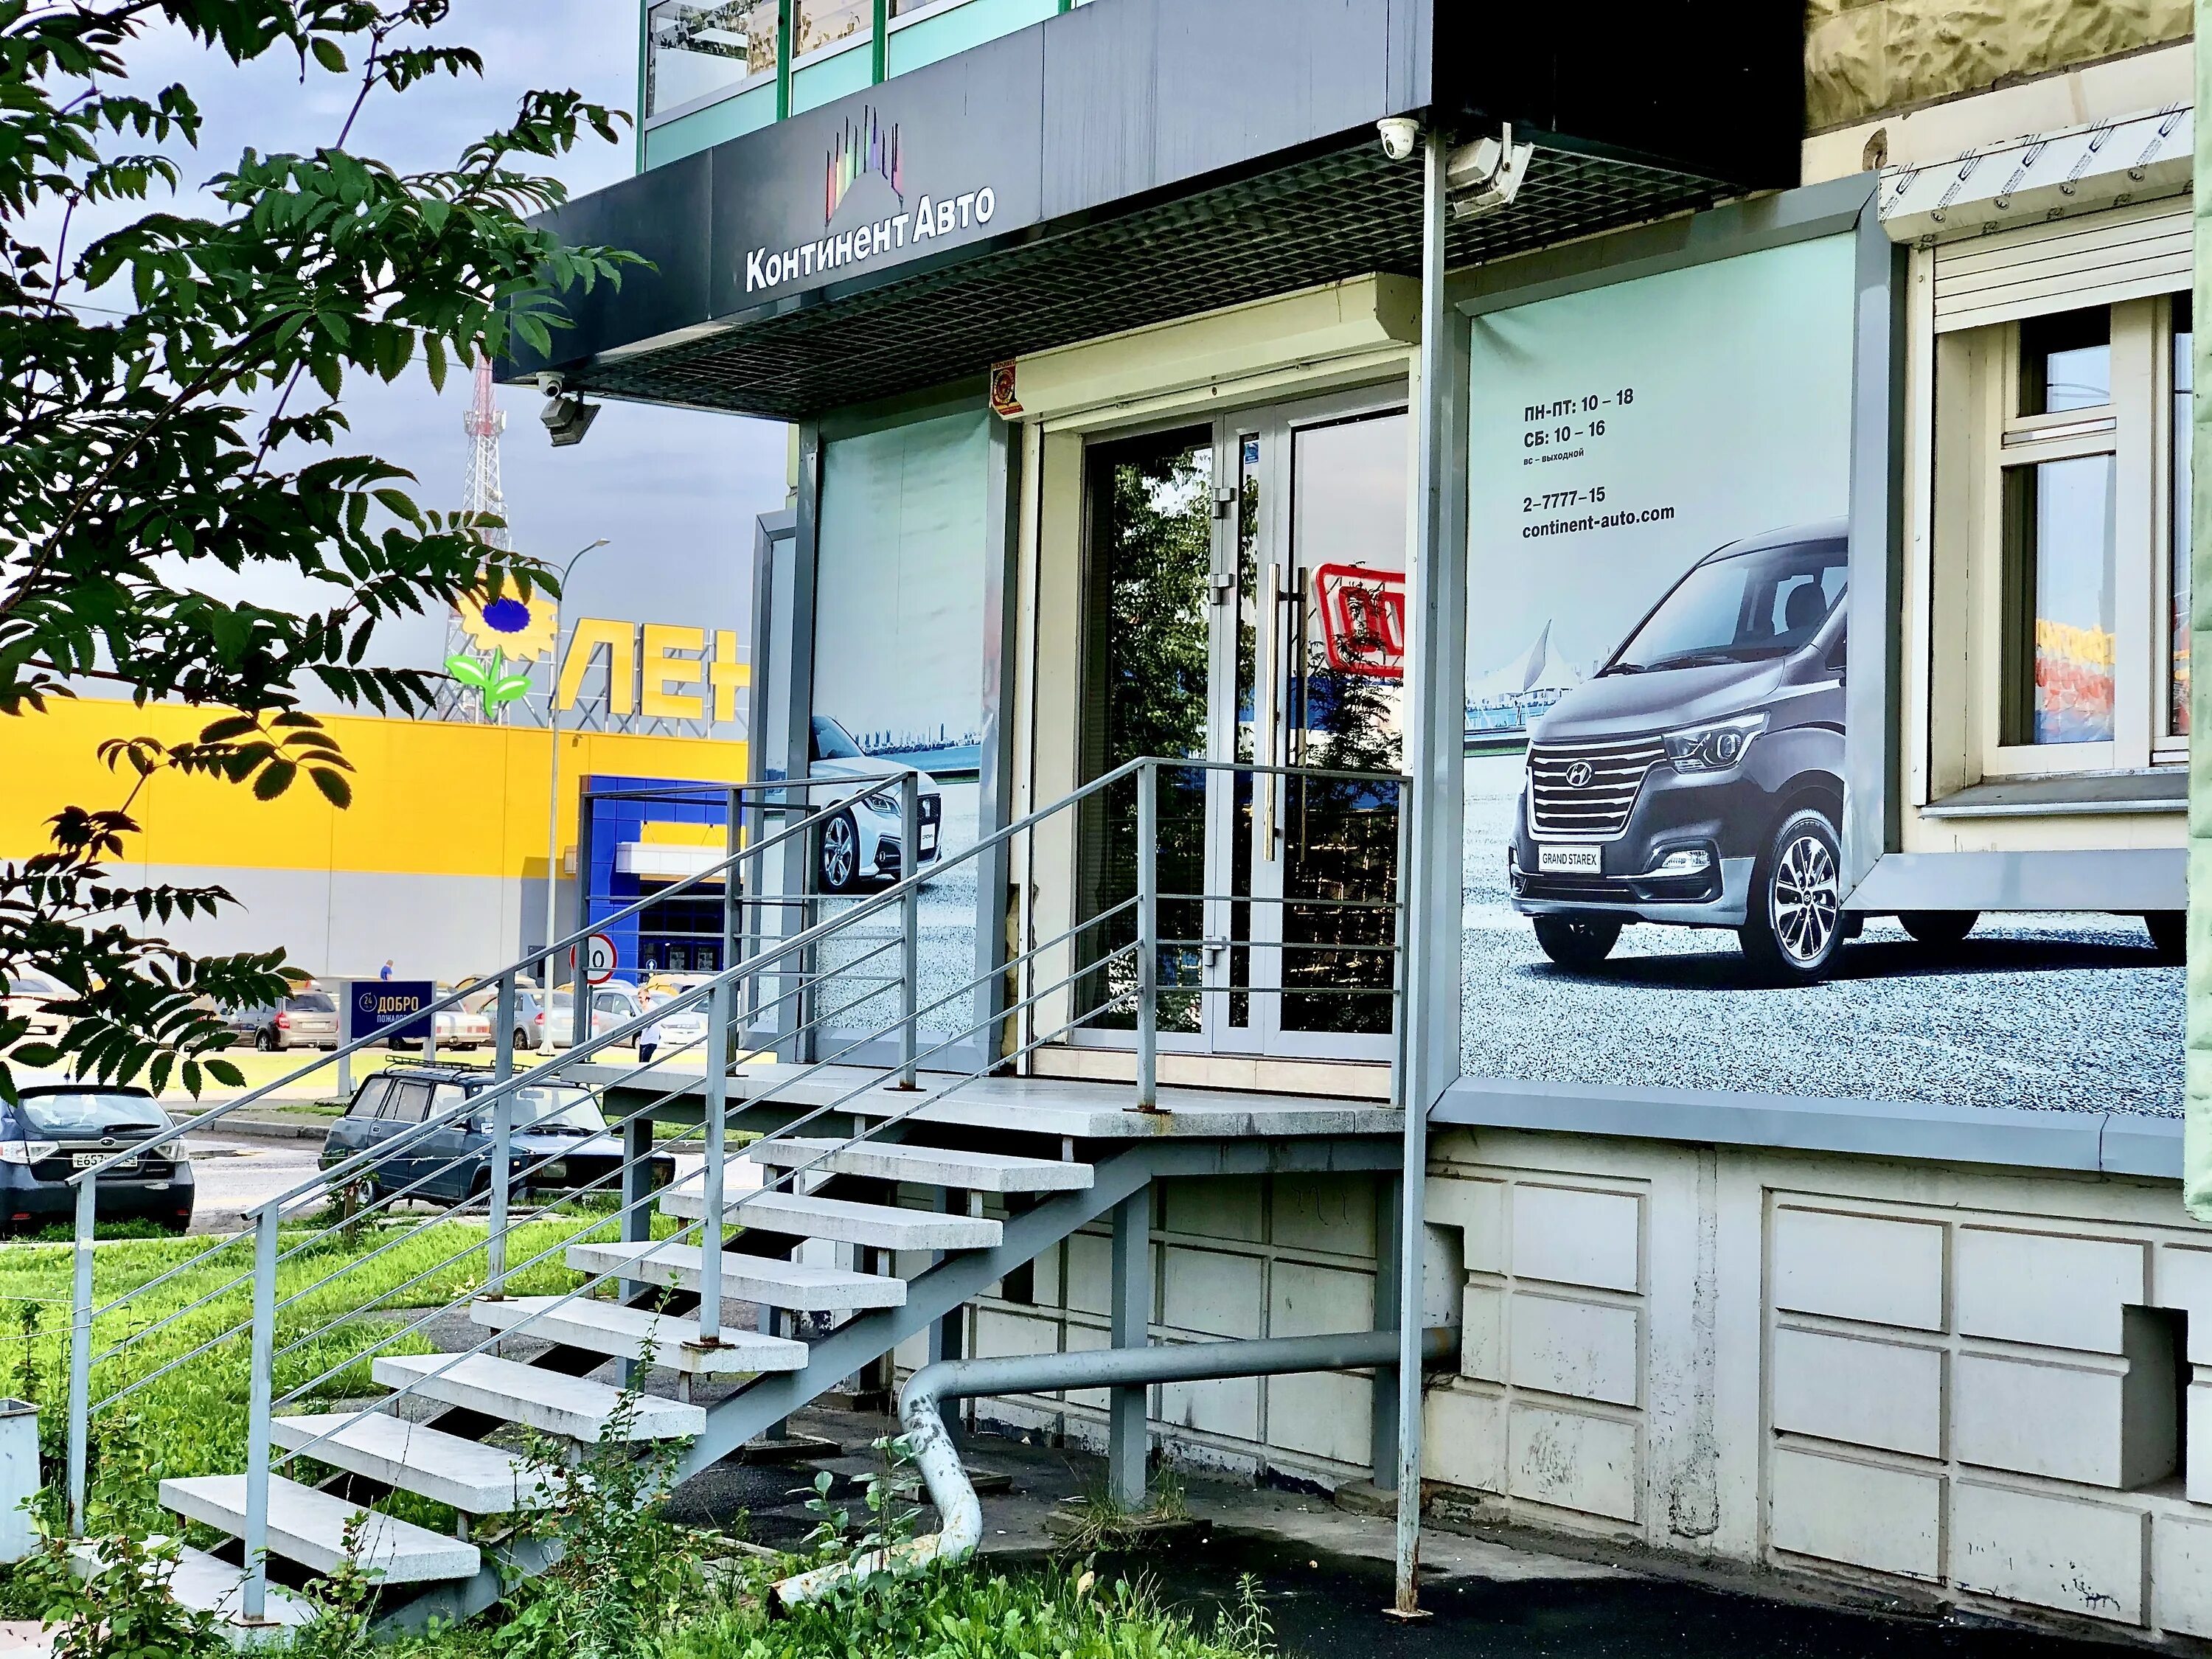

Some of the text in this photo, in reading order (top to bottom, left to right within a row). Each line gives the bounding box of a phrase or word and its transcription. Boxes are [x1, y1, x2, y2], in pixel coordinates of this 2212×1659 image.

[1524, 399, 1576, 422] ПН-ПТ:
[1581, 394, 1599, 411] 10
[1616, 388, 1634, 406] 18
[1524, 430, 1549, 448] СБ:
[1554, 425, 1571, 442] 10
[1588, 420, 1606, 437] 16
[1523, 506, 1675, 538] continent-auto.com
[1543, 853, 1597, 866] GRAND STAREX
[378, 996, 419, 1014] ДОБРО
